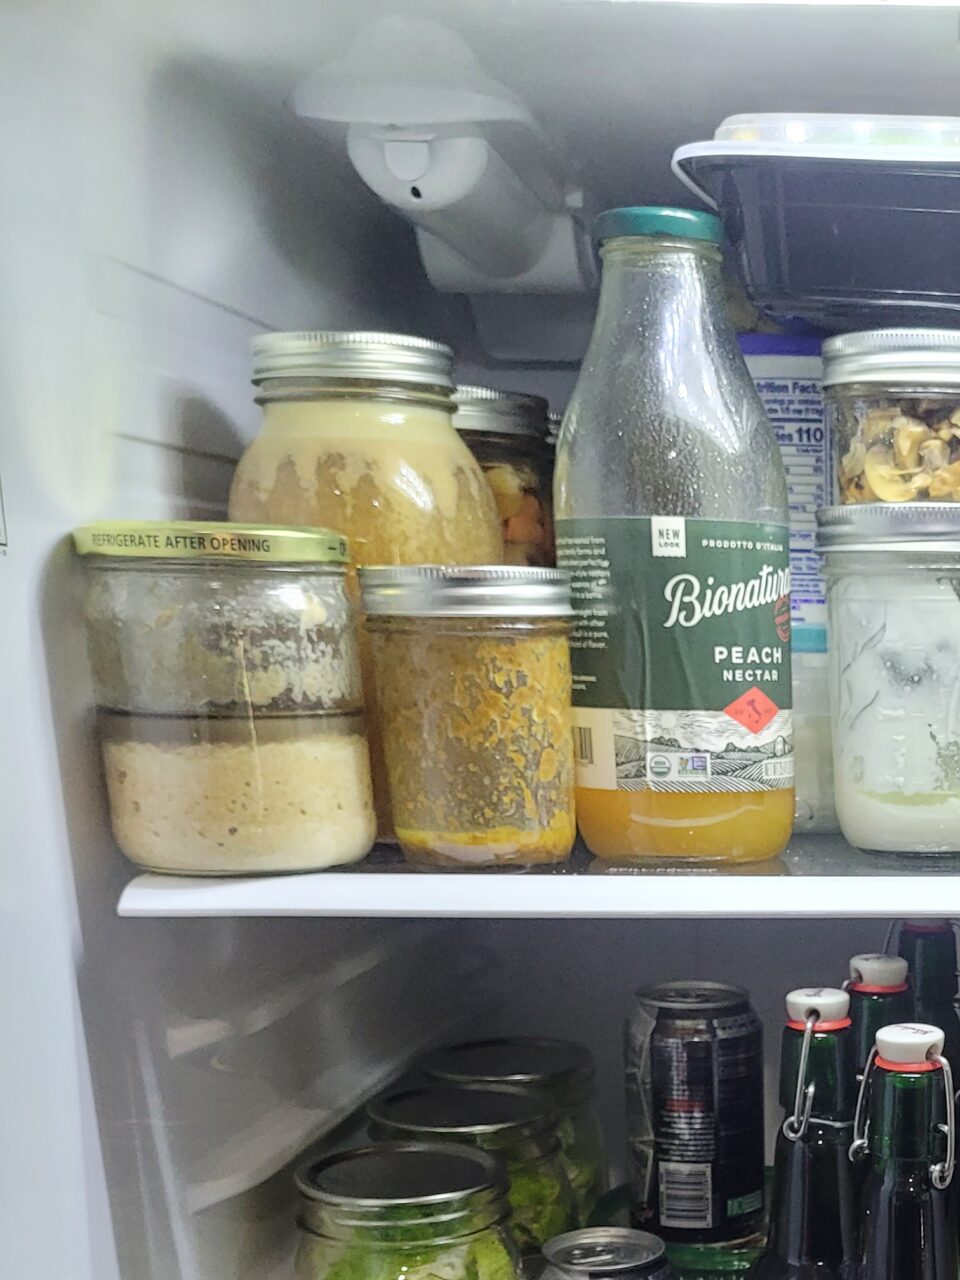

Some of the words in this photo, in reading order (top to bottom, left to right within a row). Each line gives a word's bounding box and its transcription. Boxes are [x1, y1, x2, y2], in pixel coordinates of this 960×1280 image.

[795, 427, 823, 442] 110
[658, 529, 680, 539] NEW
[92, 534, 160, 549] REFRIGERATE
[165, 535, 206, 550] AFTER
[210, 537, 271, 553] OPENING
[702, 539, 753, 549] PRODOTTO
[714, 645, 783, 664] PEACH
[723, 669, 779, 682] NECTAR
